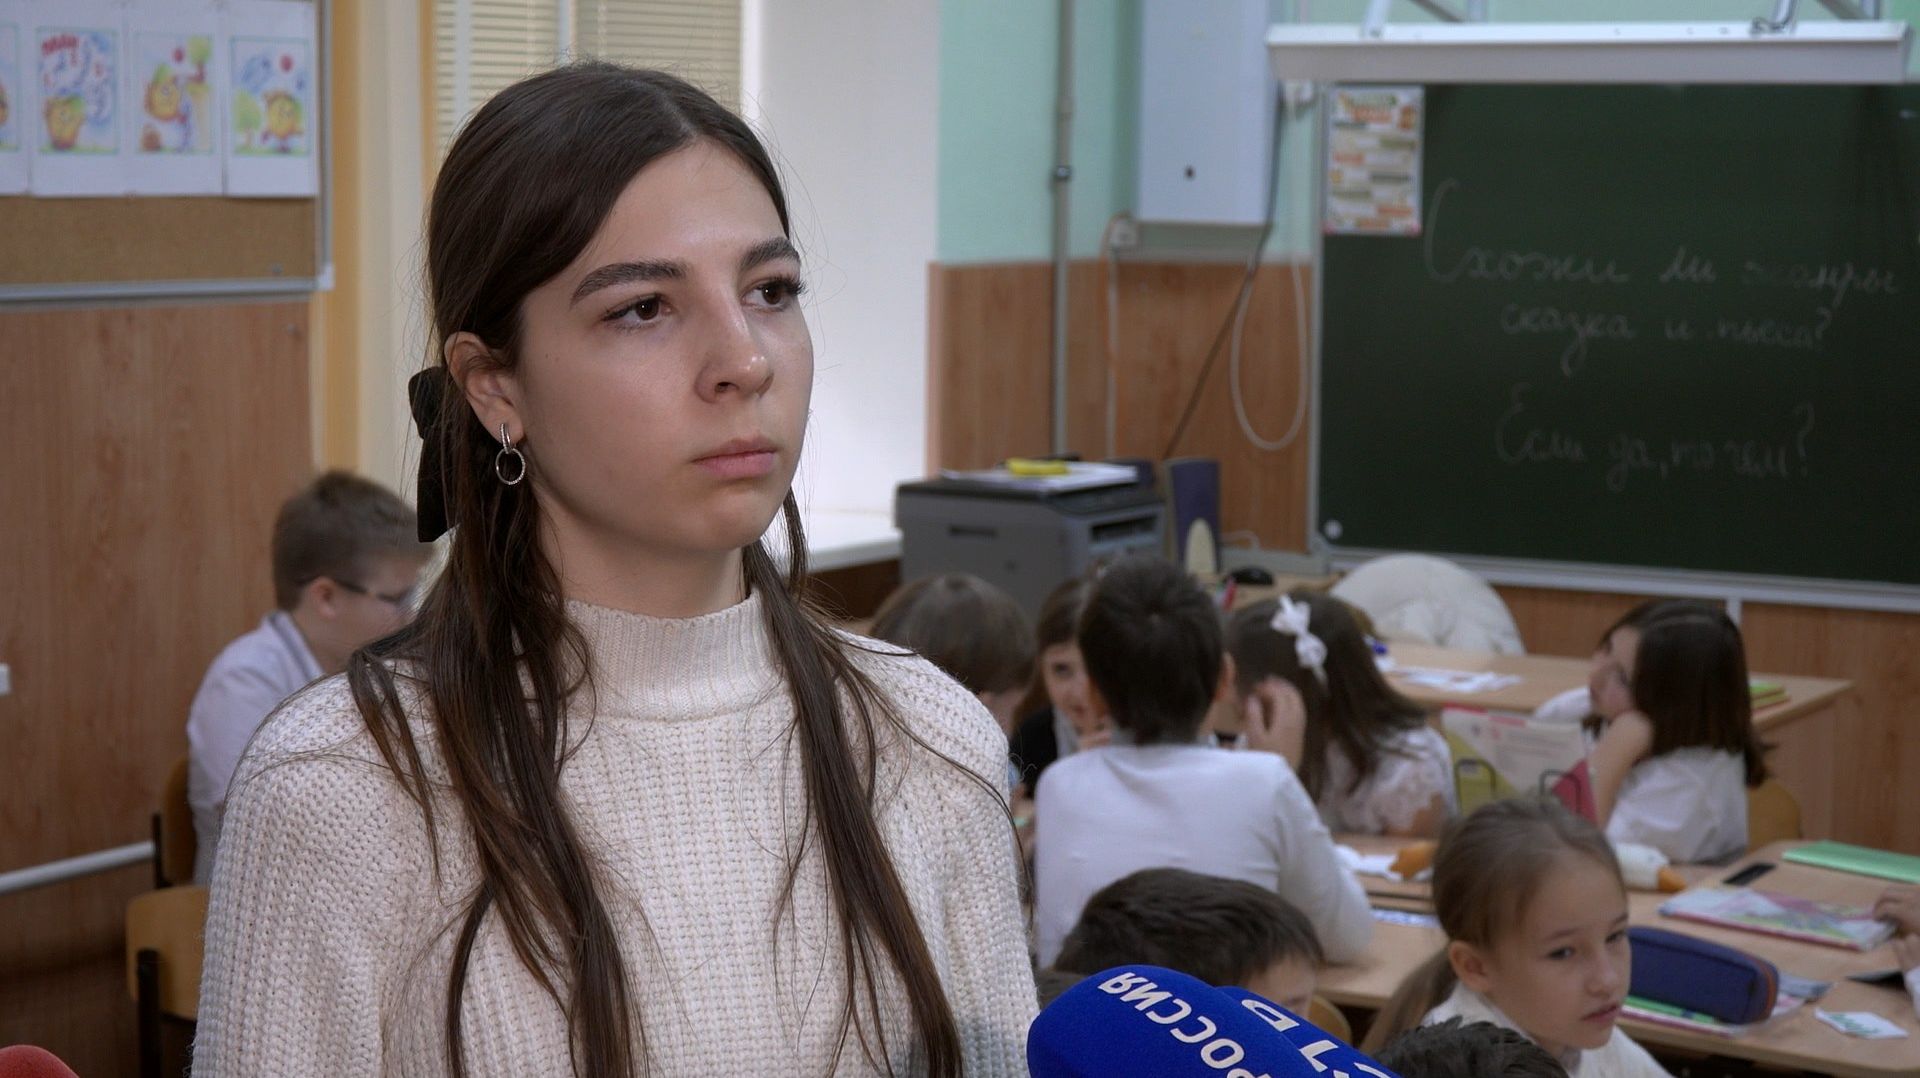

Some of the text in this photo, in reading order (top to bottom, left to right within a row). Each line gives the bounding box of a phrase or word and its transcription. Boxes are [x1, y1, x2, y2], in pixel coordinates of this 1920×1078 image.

[1424, 178, 1629, 283] Схожи
[1659, 246, 1717, 283] ли
[1501, 303, 1636, 377] сказка
[1664, 319, 1694, 340] и
[1495, 381, 1586, 464] Если
